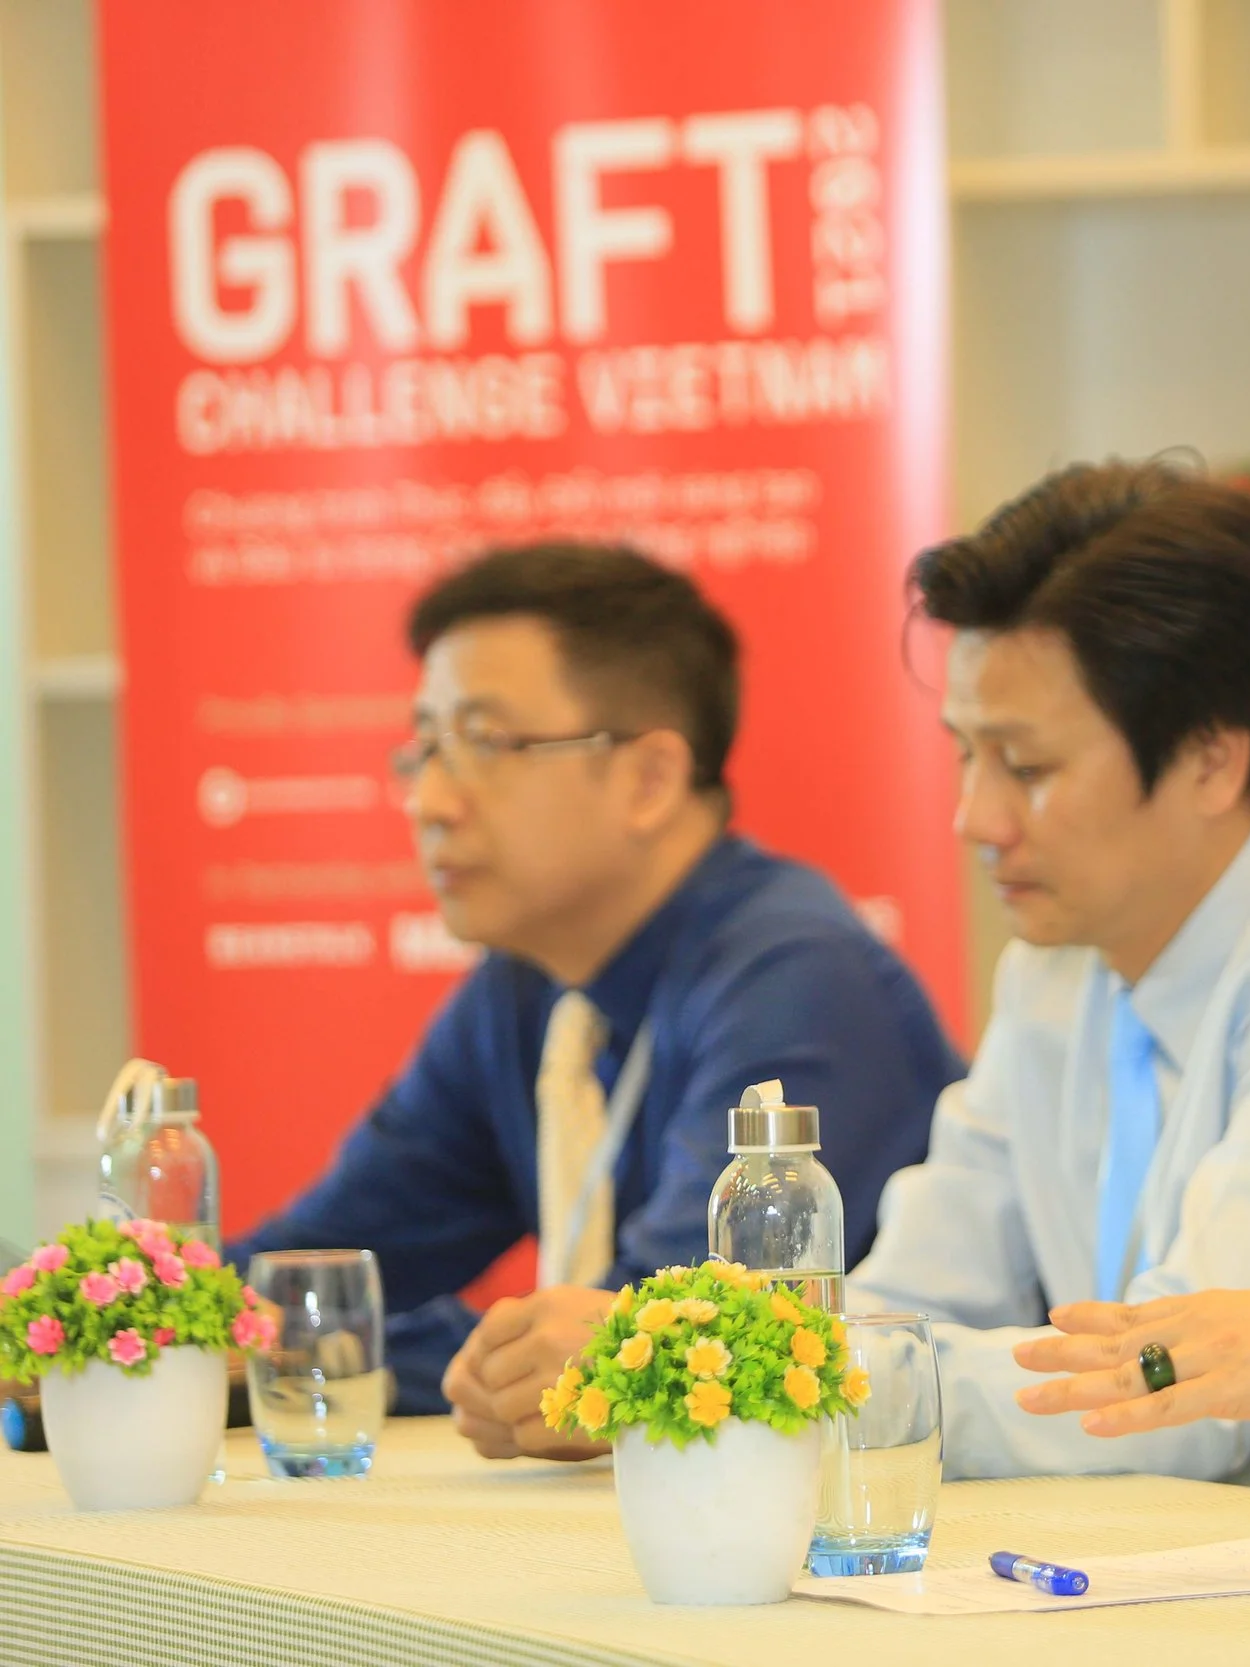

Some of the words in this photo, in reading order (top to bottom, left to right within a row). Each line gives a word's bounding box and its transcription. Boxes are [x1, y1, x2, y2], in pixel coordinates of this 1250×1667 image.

[170, 108, 802, 361] GRAFT
[809, 104, 885, 322] 2021
[178, 352, 566, 454] CHALLENGE
[579, 338, 888, 434] VIETNAM
